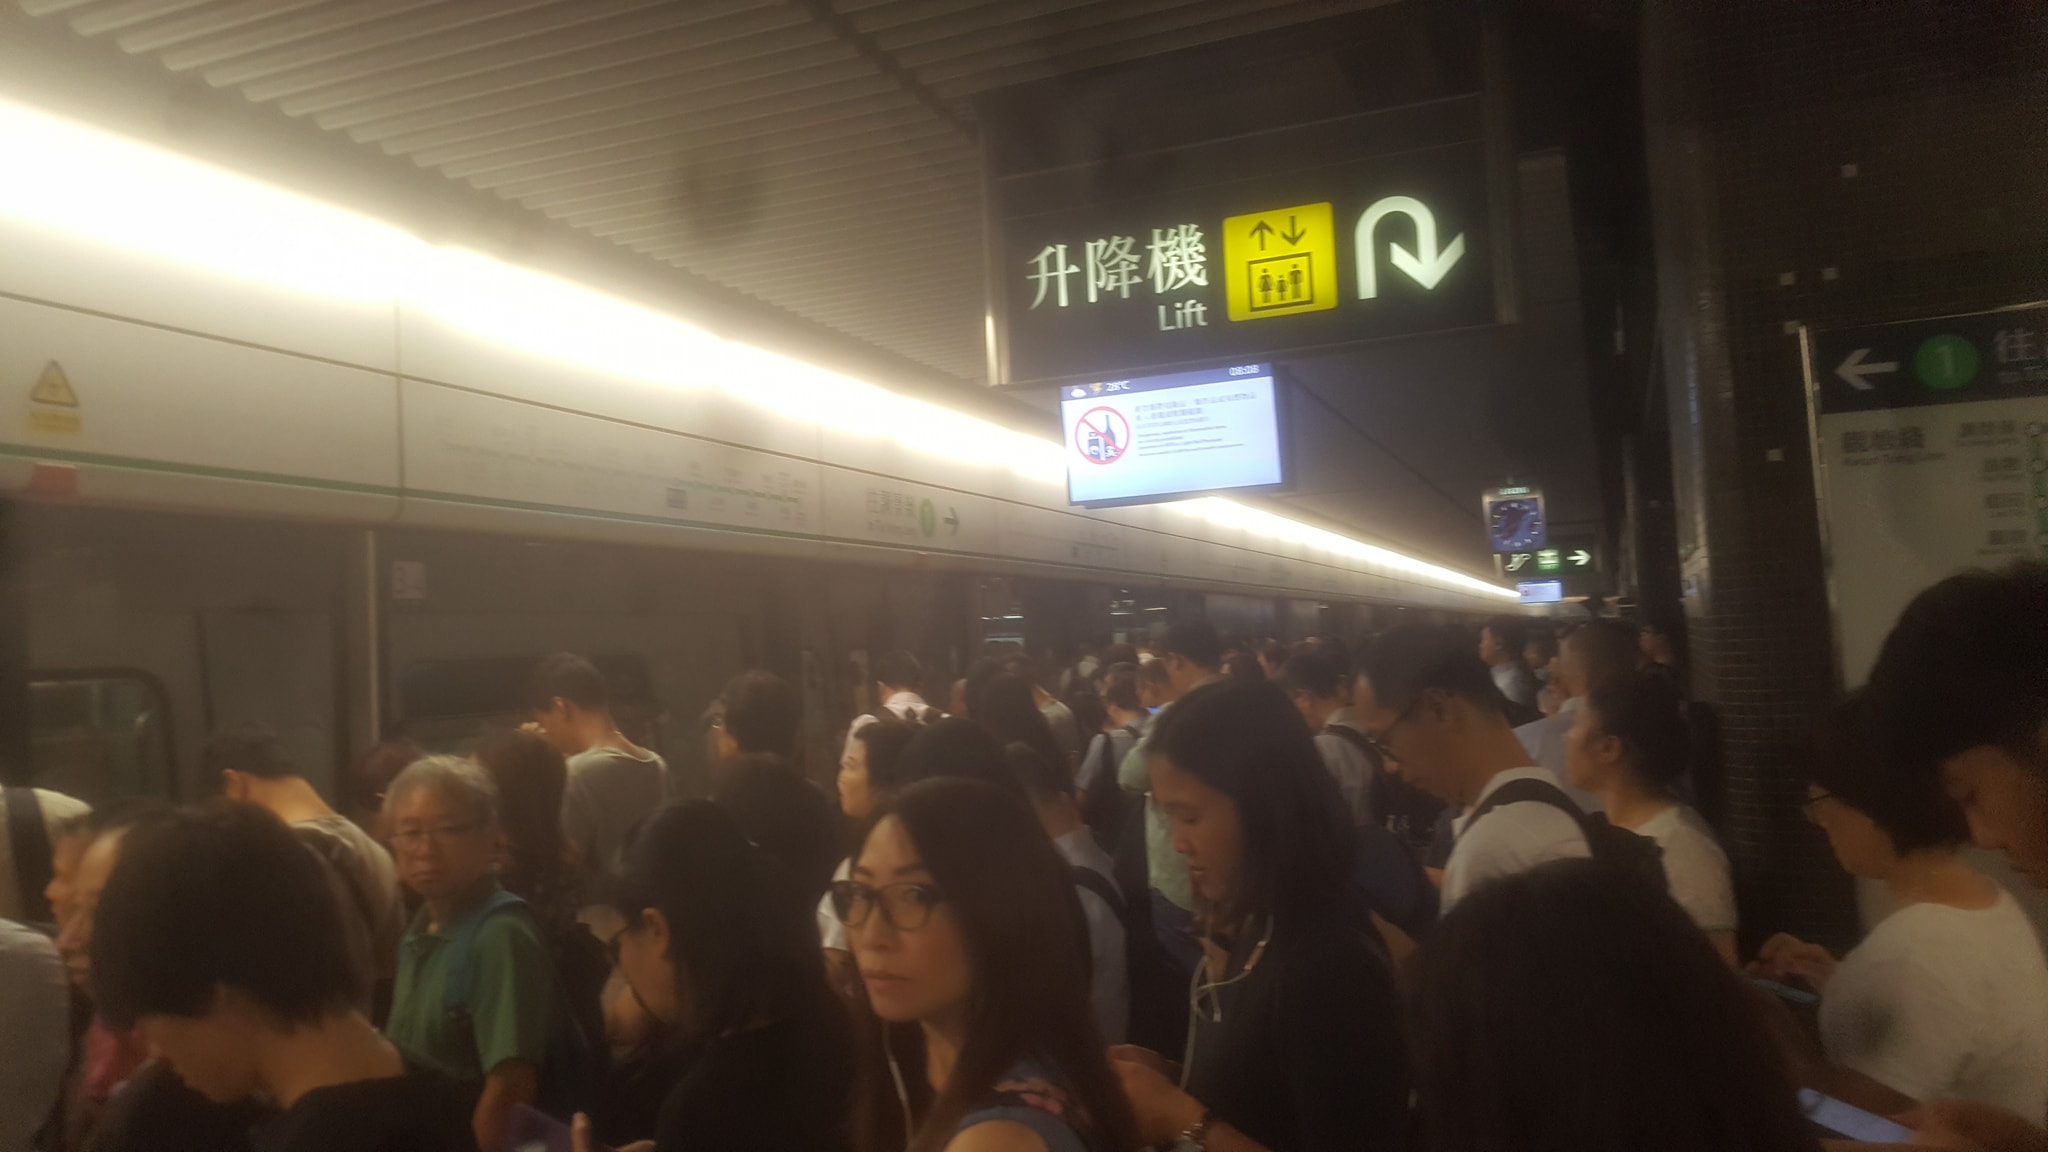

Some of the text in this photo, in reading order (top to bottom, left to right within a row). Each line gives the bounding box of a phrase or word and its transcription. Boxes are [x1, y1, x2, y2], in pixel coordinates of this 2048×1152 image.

[1026, 224, 1209, 310] 升降機
[1158, 300, 1208, 331] Lift
[1936, 345, 1954, 379] 1
